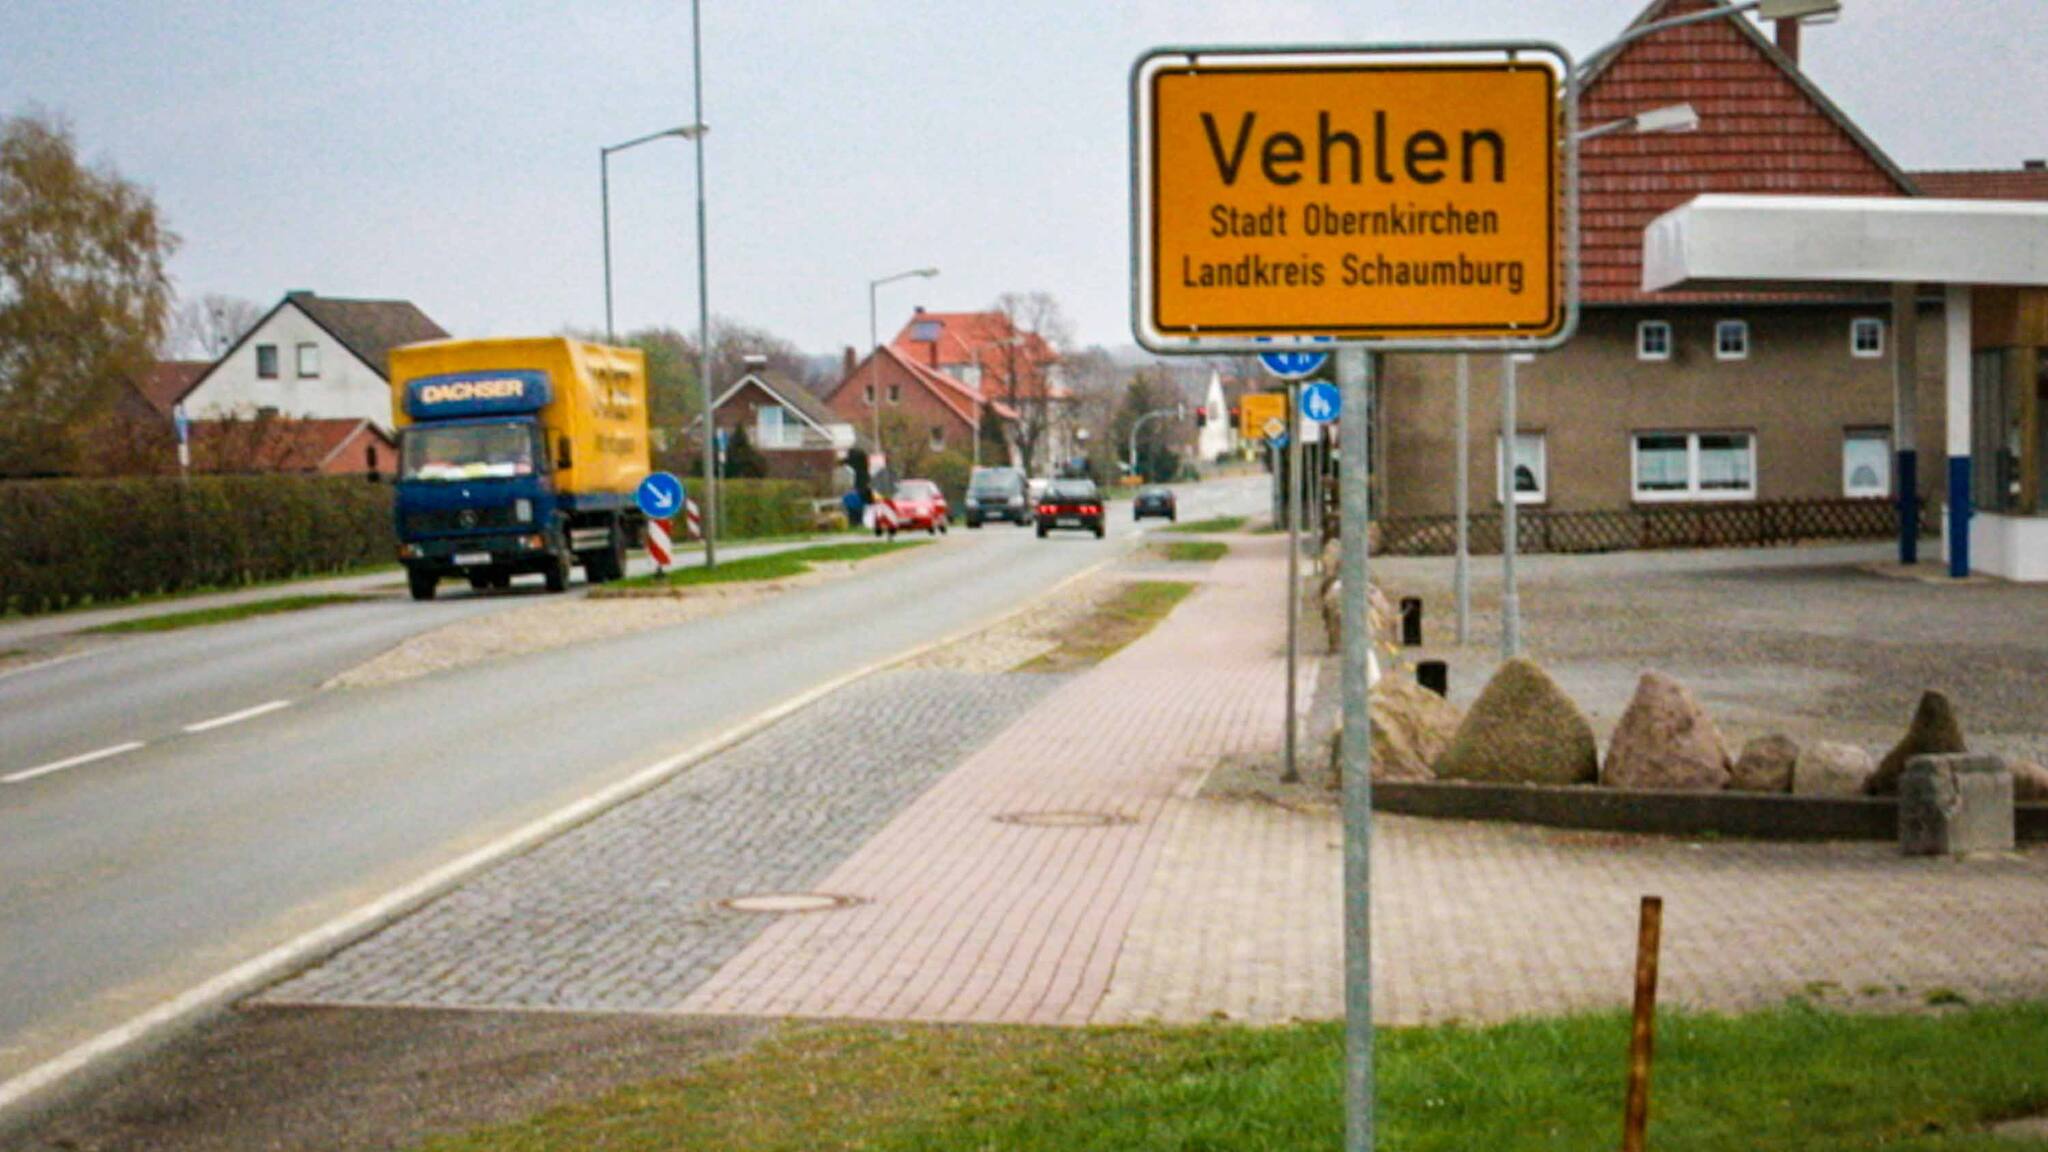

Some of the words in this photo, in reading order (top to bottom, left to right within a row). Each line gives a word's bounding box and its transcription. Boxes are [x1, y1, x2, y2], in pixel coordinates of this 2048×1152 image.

[1199, 110, 1506, 185] Vehlen
[1210, 204, 1286, 237] Stadt
[1303, 202, 1498, 236] Obernkirchen
[1183, 254, 1325, 287] Landkreis
[1342, 253, 1524, 294] Schaumburg
[421, 380, 524, 403] DACHSER
